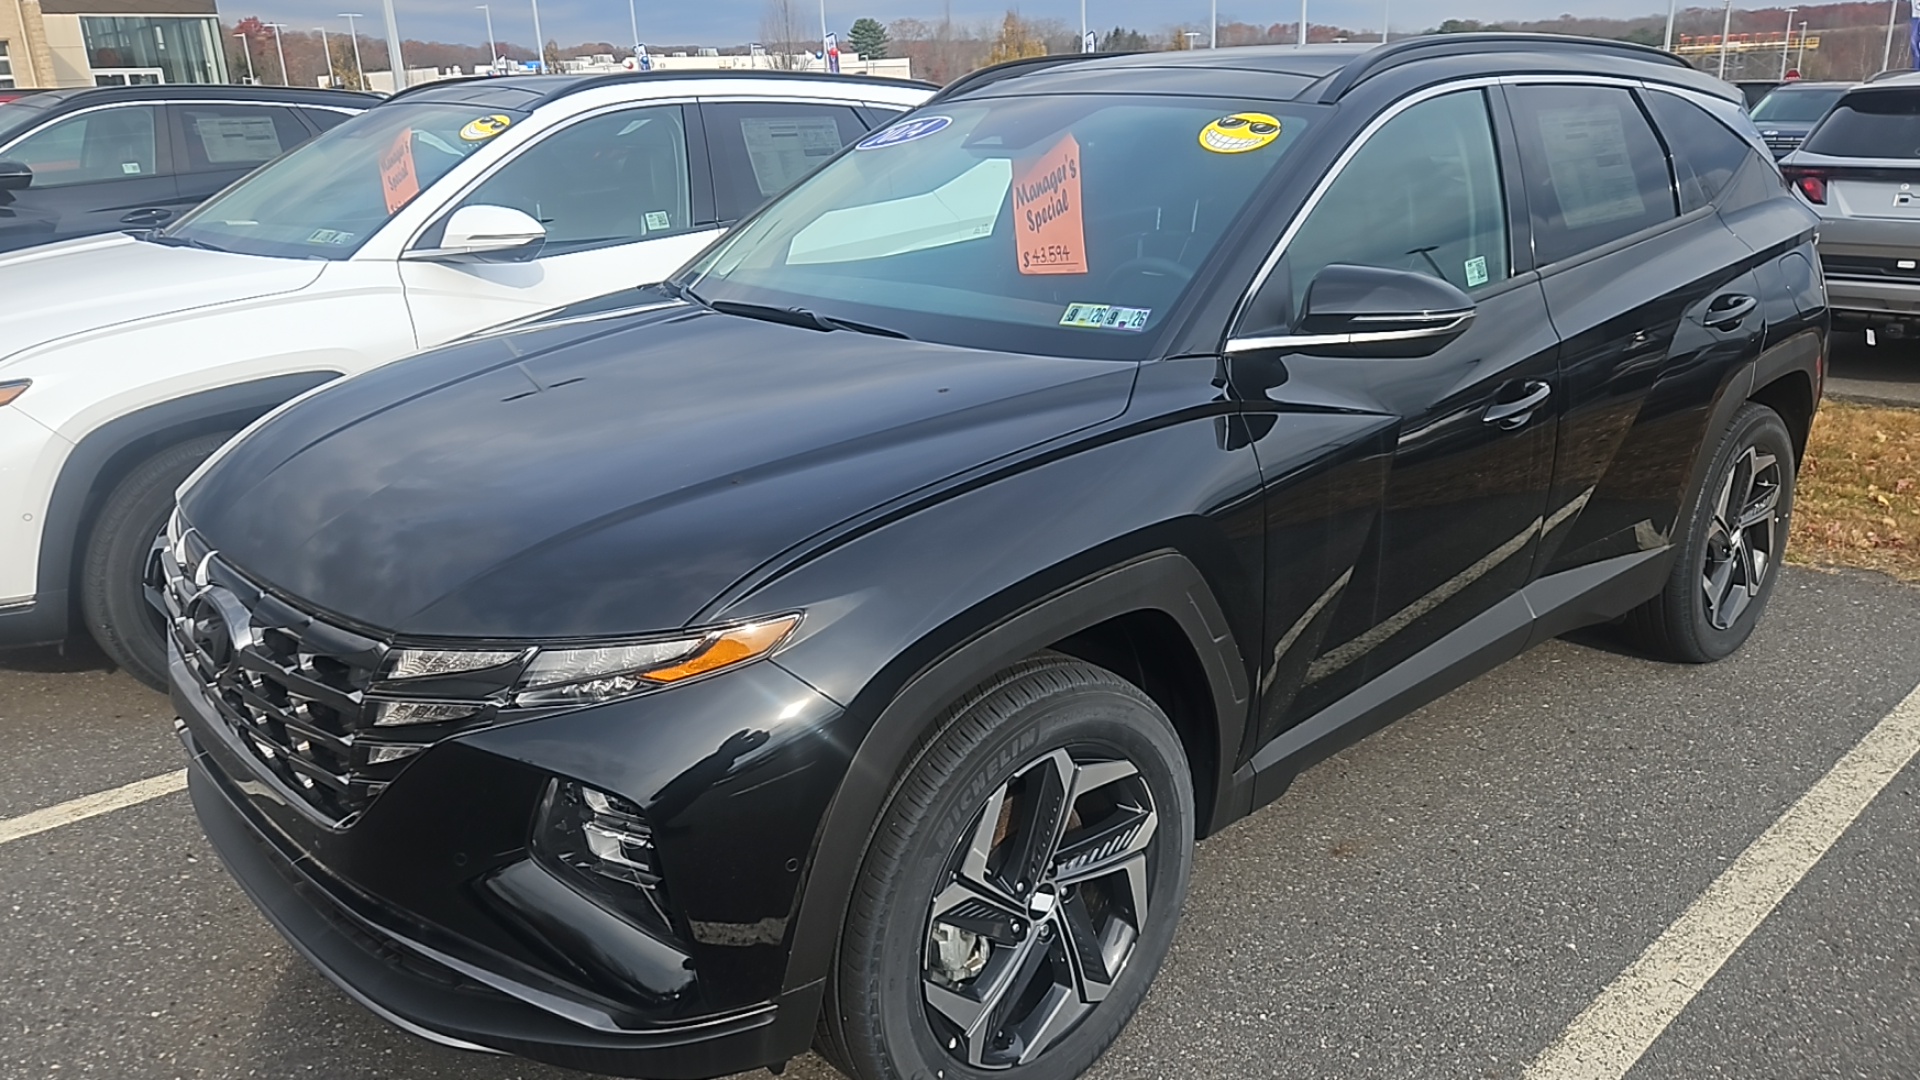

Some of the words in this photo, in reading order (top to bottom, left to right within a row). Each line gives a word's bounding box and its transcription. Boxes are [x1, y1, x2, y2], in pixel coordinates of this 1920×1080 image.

[1016, 155, 1076, 209] Manager's
[1026, 188, 1069, 233] Special
[935, 727, 1036, 848] MICHELIN
